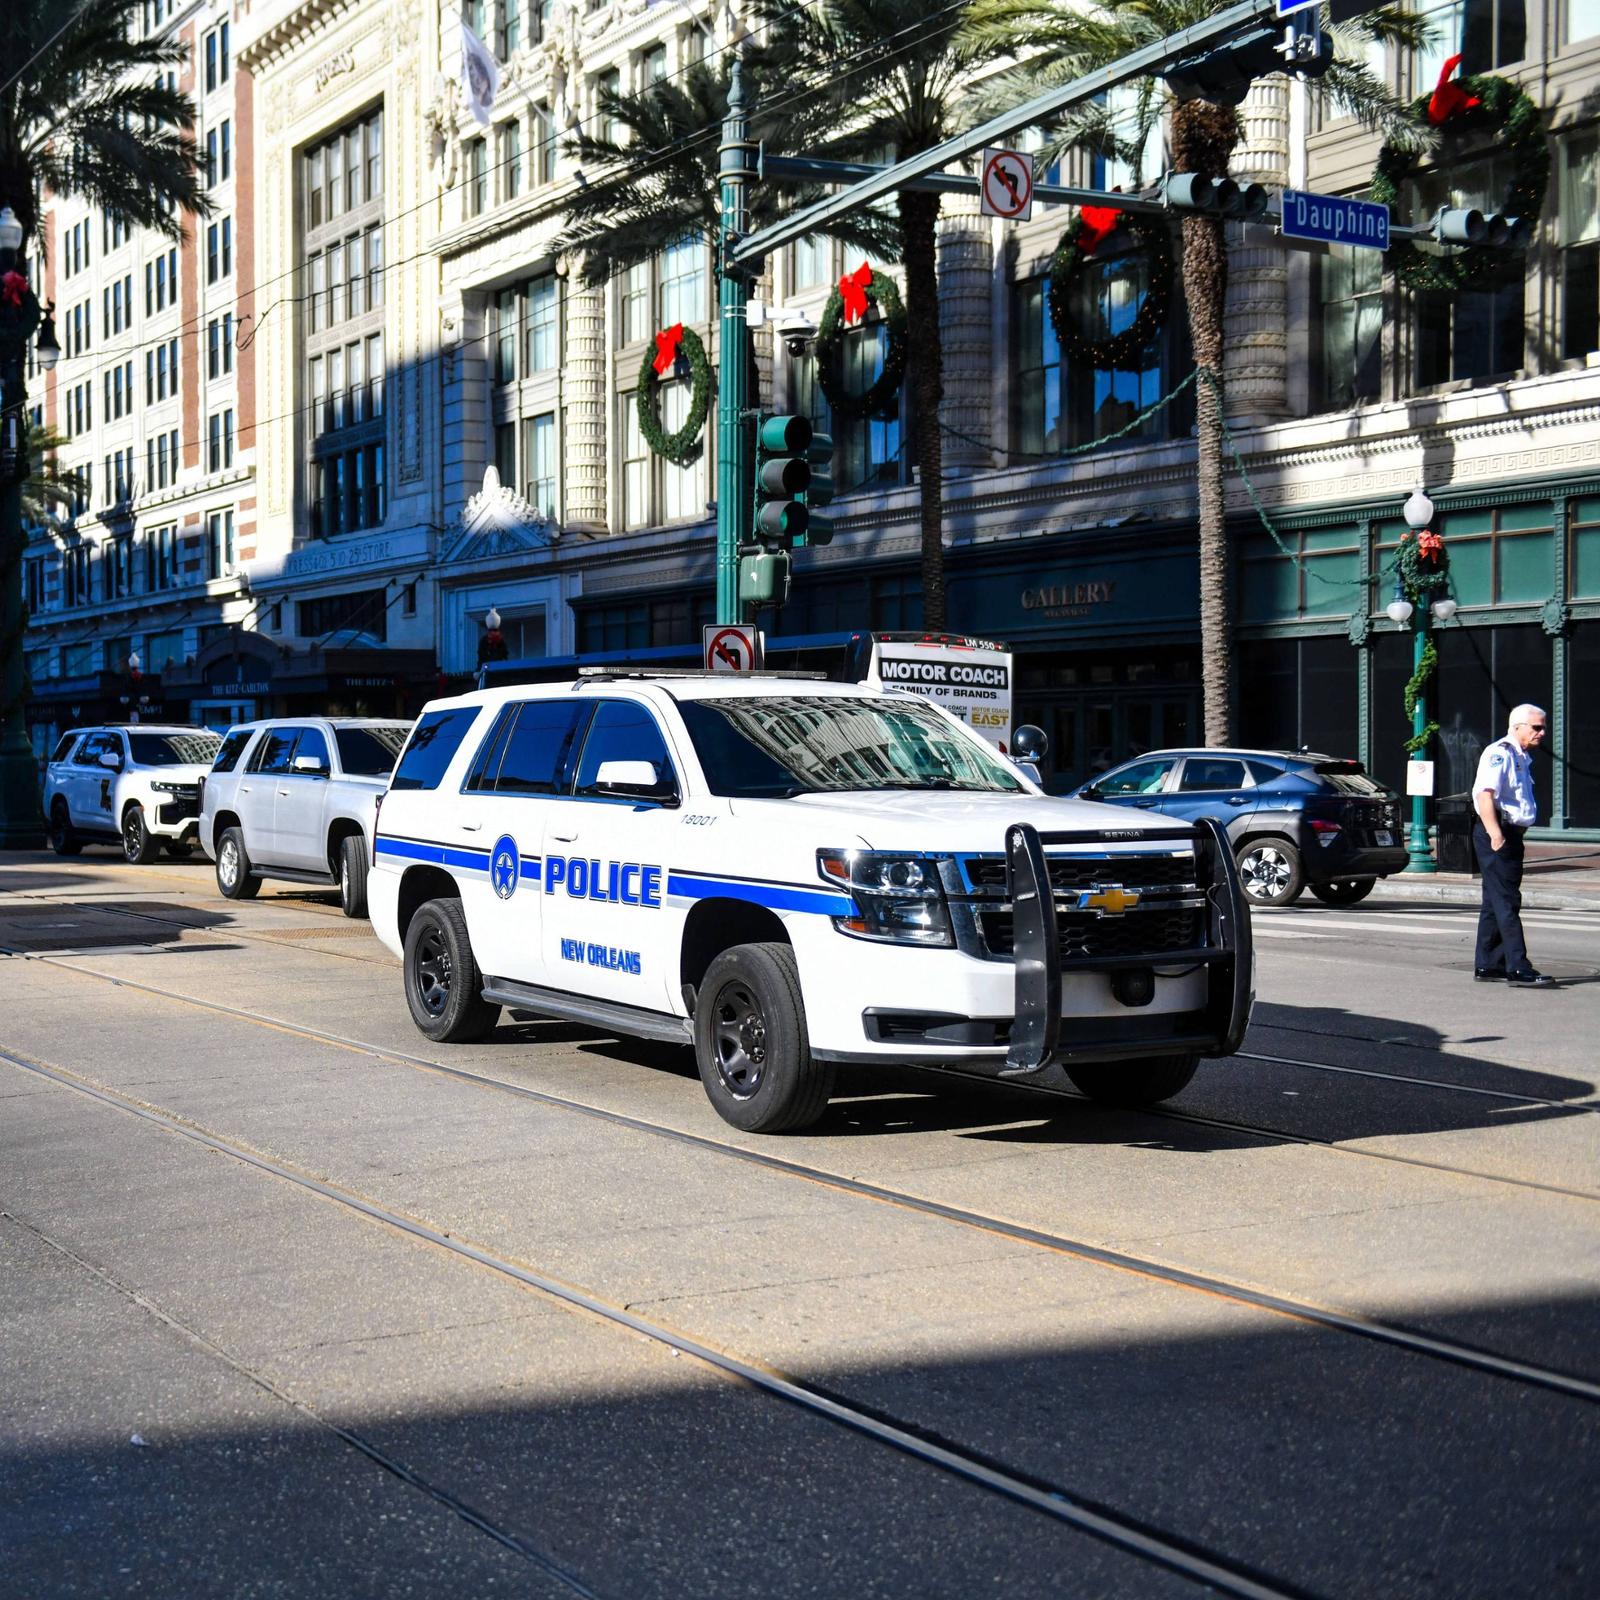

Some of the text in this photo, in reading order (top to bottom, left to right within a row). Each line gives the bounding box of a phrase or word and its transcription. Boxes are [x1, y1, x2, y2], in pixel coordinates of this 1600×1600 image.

[1297, 196, 1386, 239] Dauphine
[1021, 582, 1115, 609] GALLERY
[964, 638, 996, 650] LM 550
[881, 661, 1005, 686] MOTOR COACH
[935, 687, 950, 696] OF
[953, 688, 997, 699] BRANDS
[971, 713, 1010, 726] EAST
[680, 814, 718, 826] 18001
[1104, 831, 1140, 839] SETINA
[545, 854, 662, 909] POLICE
[560, 937, 641, 975] NEW ORLEANS
